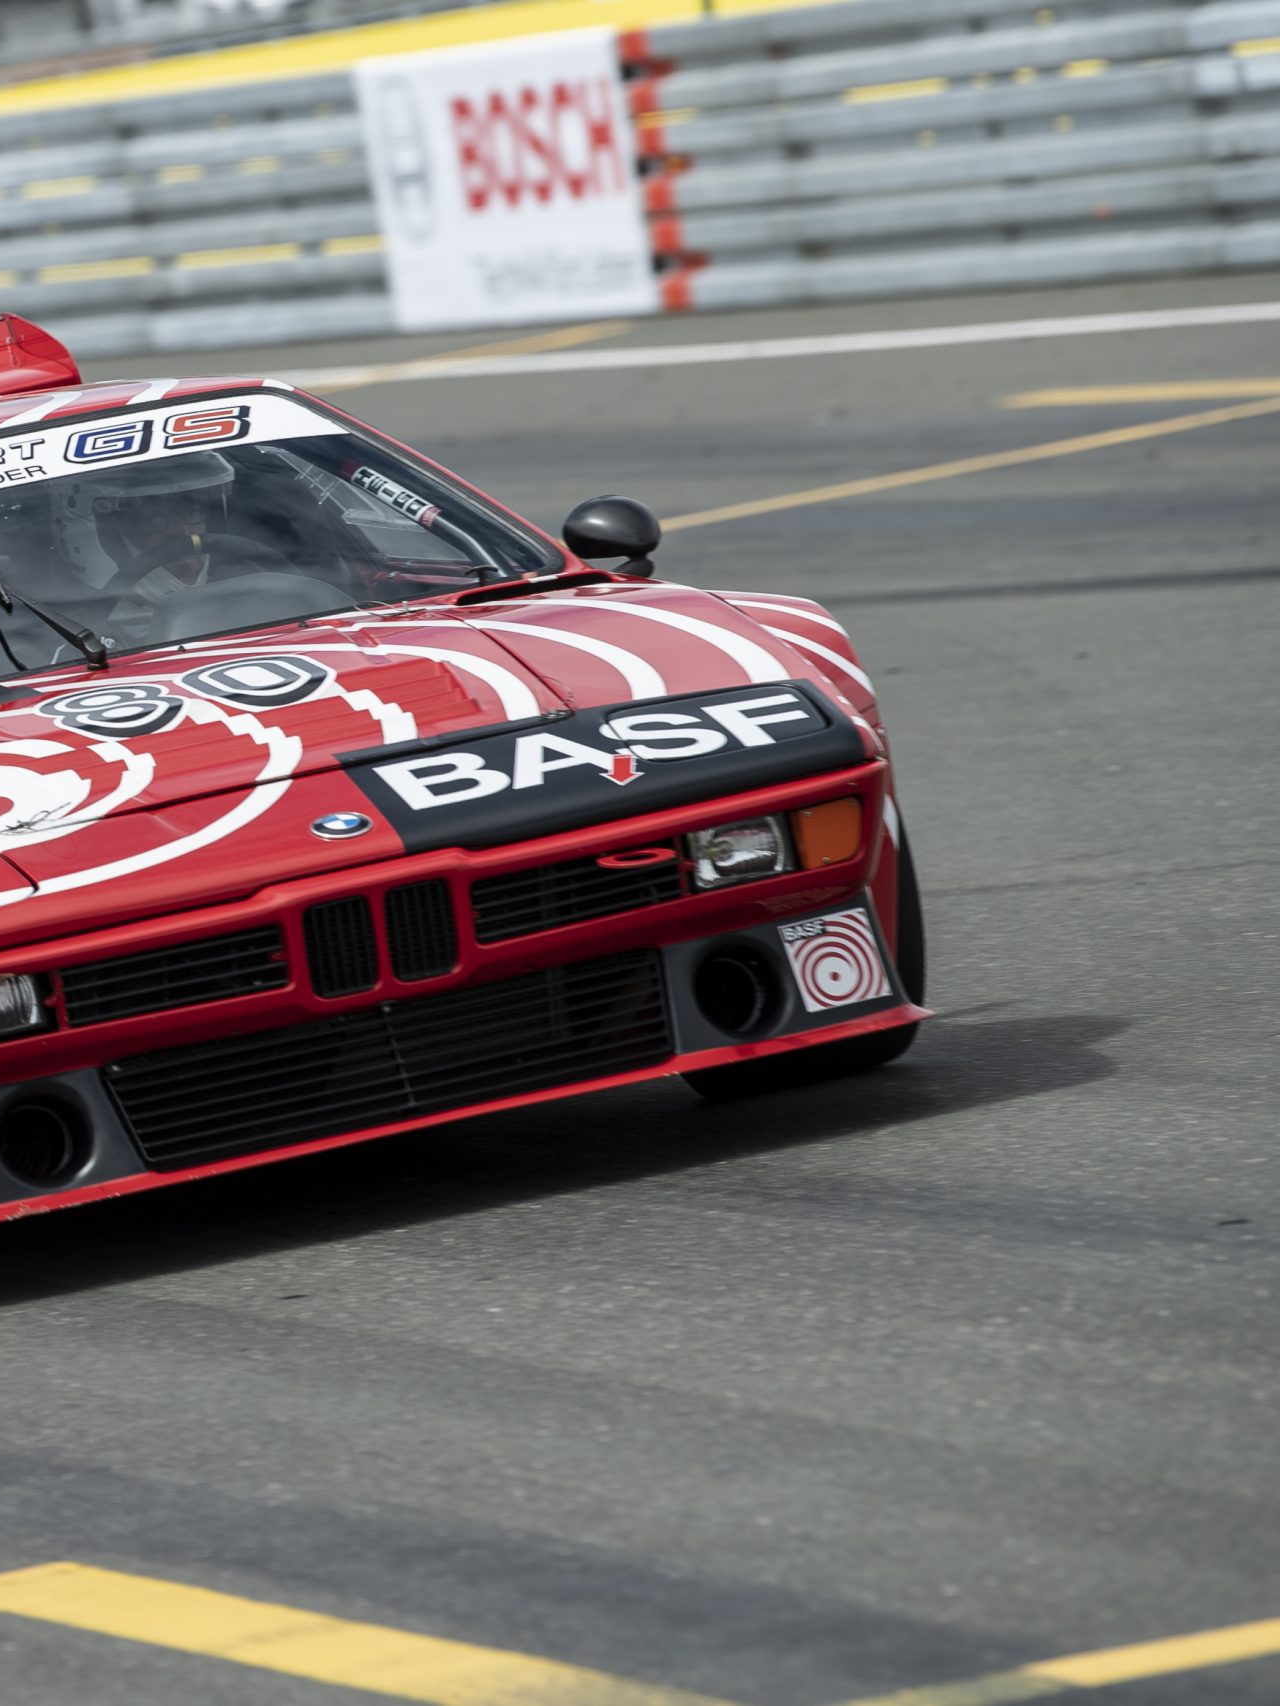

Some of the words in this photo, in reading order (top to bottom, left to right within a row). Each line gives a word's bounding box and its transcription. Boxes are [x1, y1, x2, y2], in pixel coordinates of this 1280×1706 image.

[450, 76, 627, 213] BOSCH
[33, 654, 336, 740] 80
[372, 693, 810, 810] BASF
[782, 920, 825, 941] BASF
